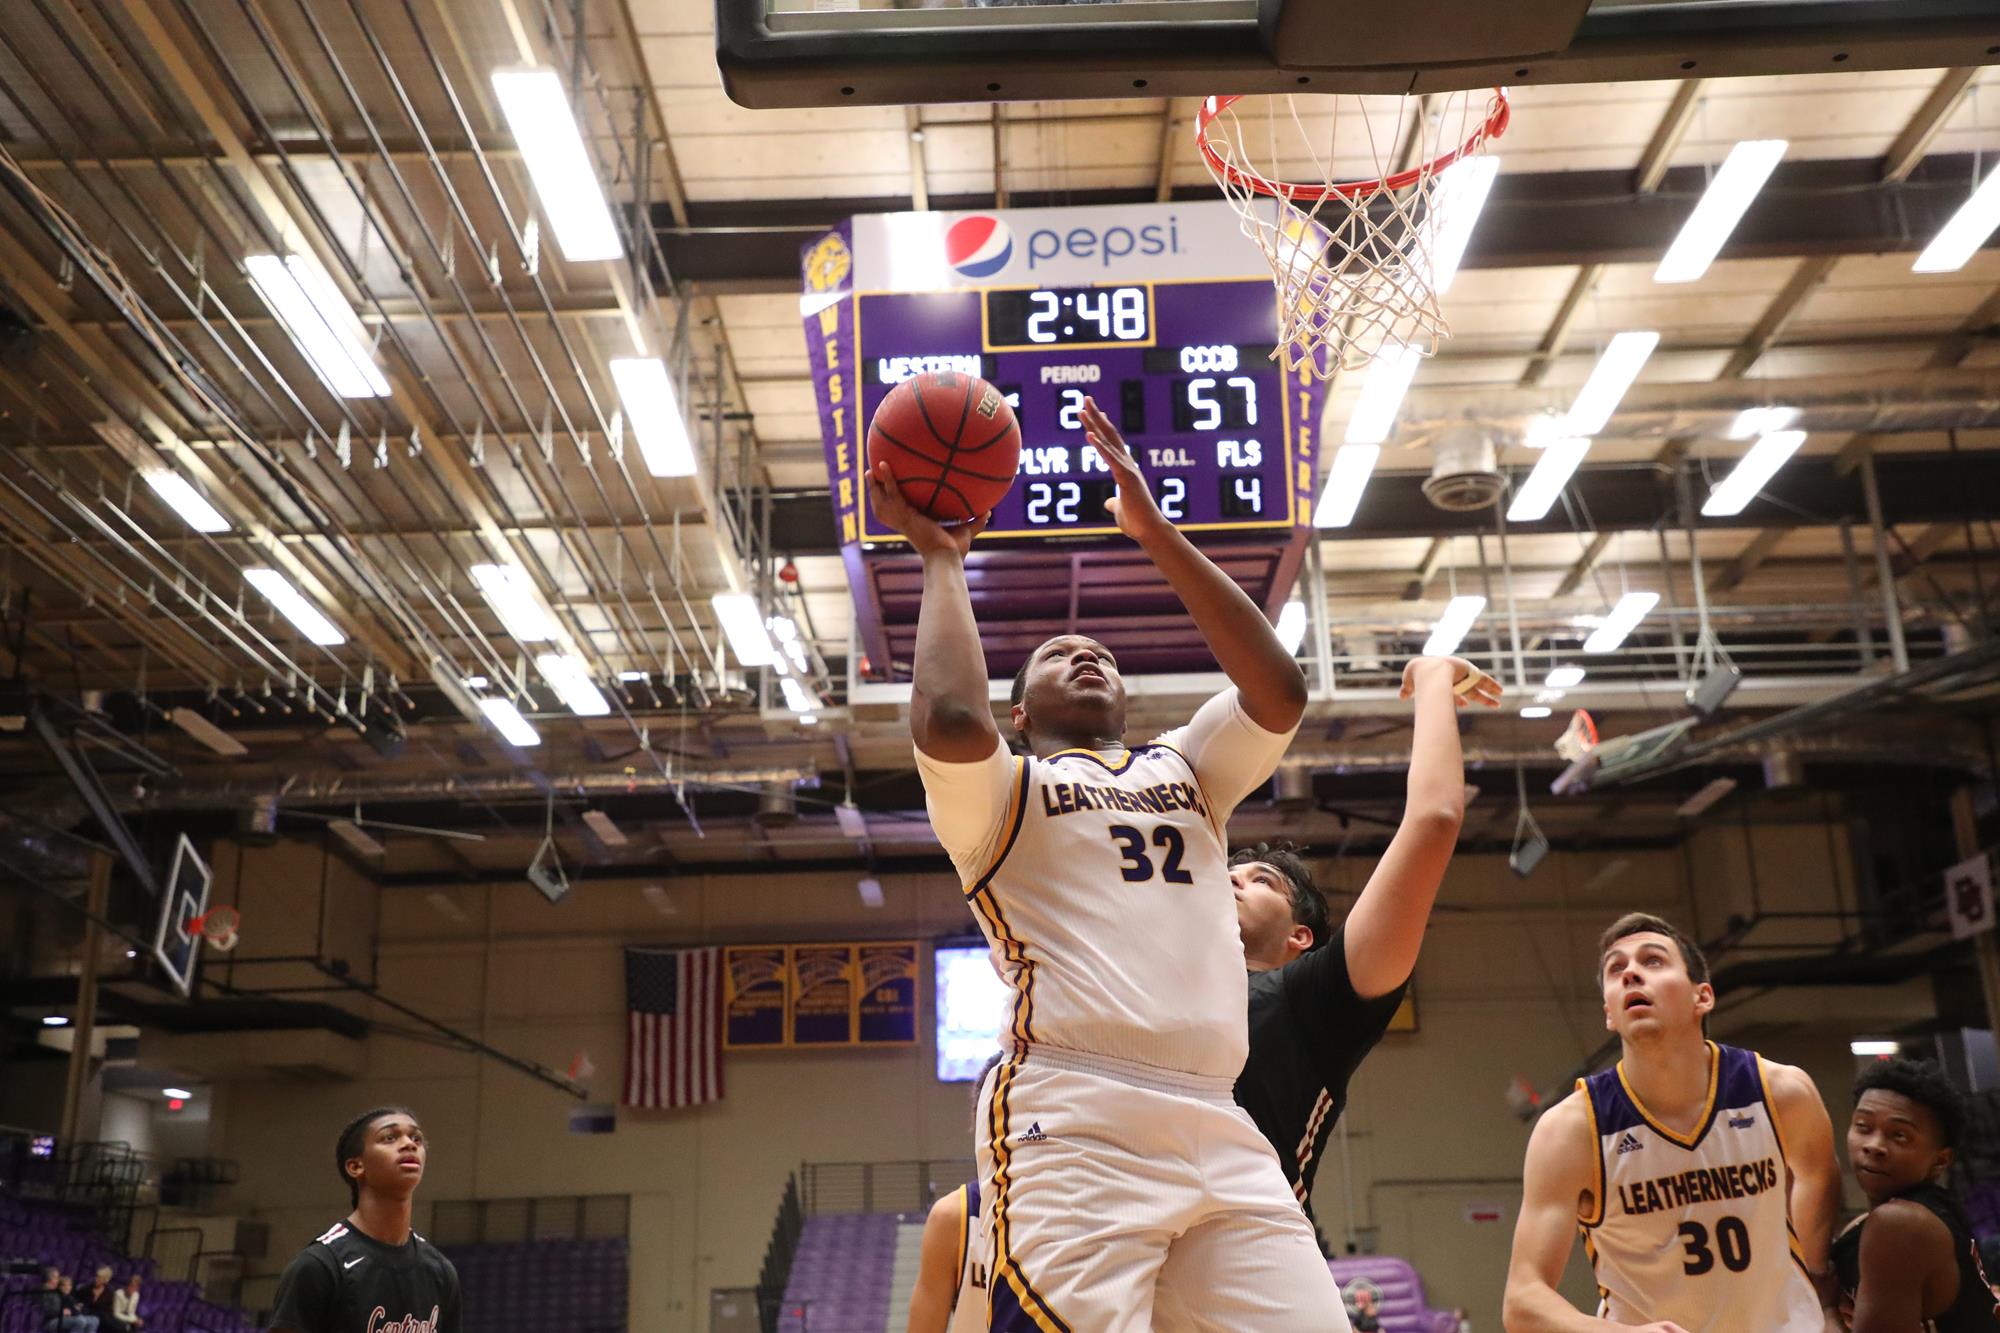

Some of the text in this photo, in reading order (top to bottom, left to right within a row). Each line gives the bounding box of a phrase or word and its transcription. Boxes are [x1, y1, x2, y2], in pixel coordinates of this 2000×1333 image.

[1028, 216, 1178, 270] pepsi
[1028, 288, 1146, 343] 2:48
[1040, 364, 1101, 385] PERIOD
[818, 303, 858, 544] WESTERN
[1060, 389, 1085, 429] 2
[1188, 377, 1257, 430] 57
[1149, 449, 1196, 467] T.O.L.
[1217, 440, 1262, 468] FLS
[1028, 482, 1081, 523] 22
[1161, 478, 1186, 519] 2
[1235, 478, 1261, 512] 4
[1109, 825, 1194, 885] 32
[1618, 1158, 1777, 1216] LEATHERNECKS
[1678, 1216, 1752, 1276] 30
